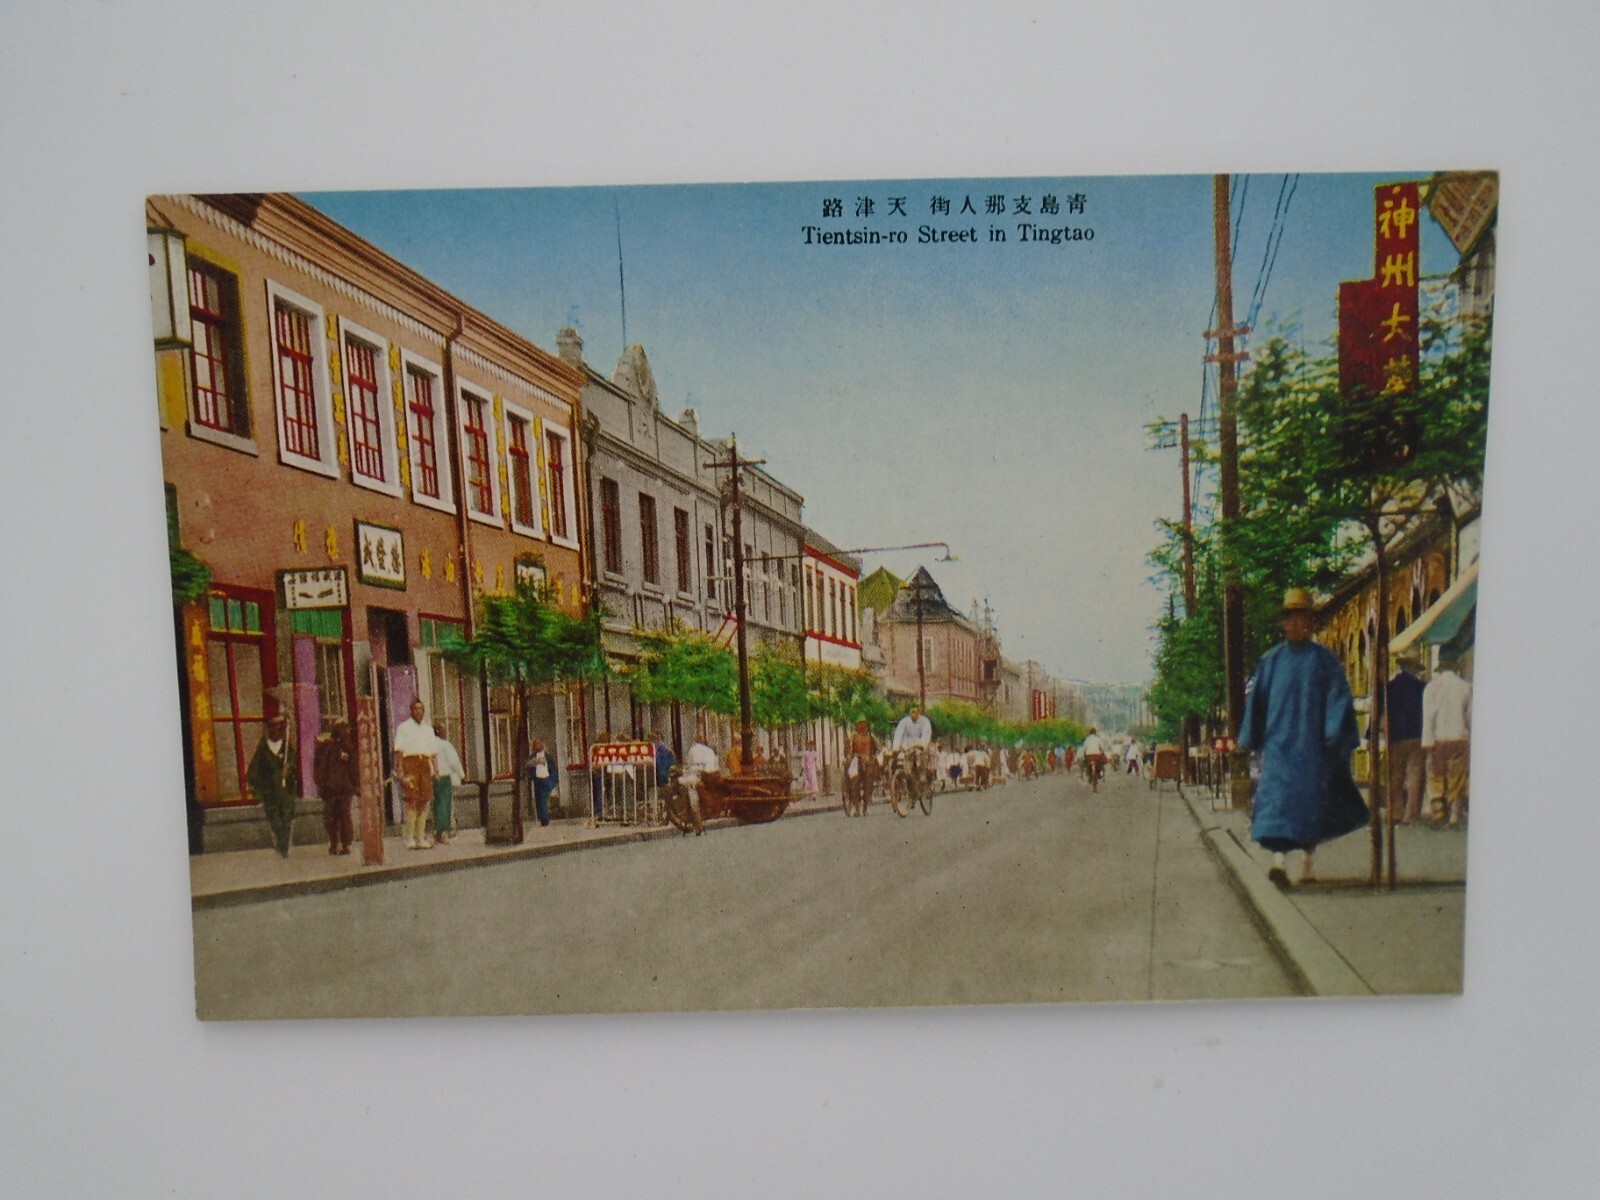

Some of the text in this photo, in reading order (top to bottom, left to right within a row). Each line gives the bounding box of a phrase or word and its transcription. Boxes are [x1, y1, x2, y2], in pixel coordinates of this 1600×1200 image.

[802, 223, 1095, 244] Tientsin-ro Street in Tingtao
